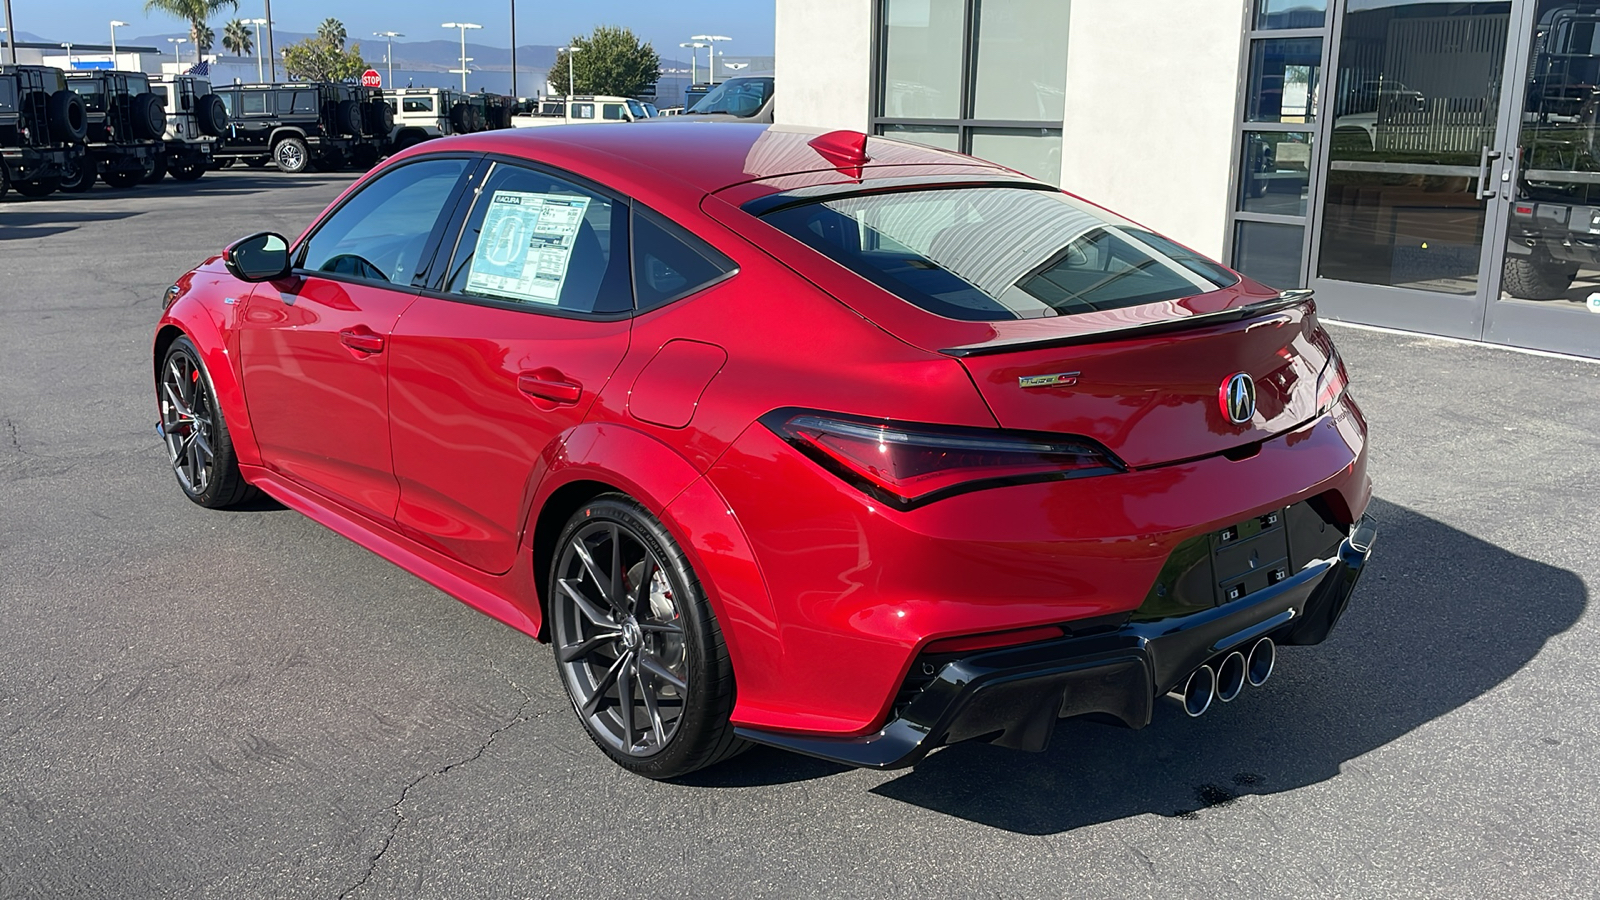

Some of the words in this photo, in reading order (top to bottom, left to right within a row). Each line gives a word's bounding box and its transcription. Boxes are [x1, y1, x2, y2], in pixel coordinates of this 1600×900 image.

[363, 76, 380, 85] STOP
[501, 196, 520, 204] ACURA
[1052, 371, 1080, 388] S
[645, 533, 662, 552] SPORT
